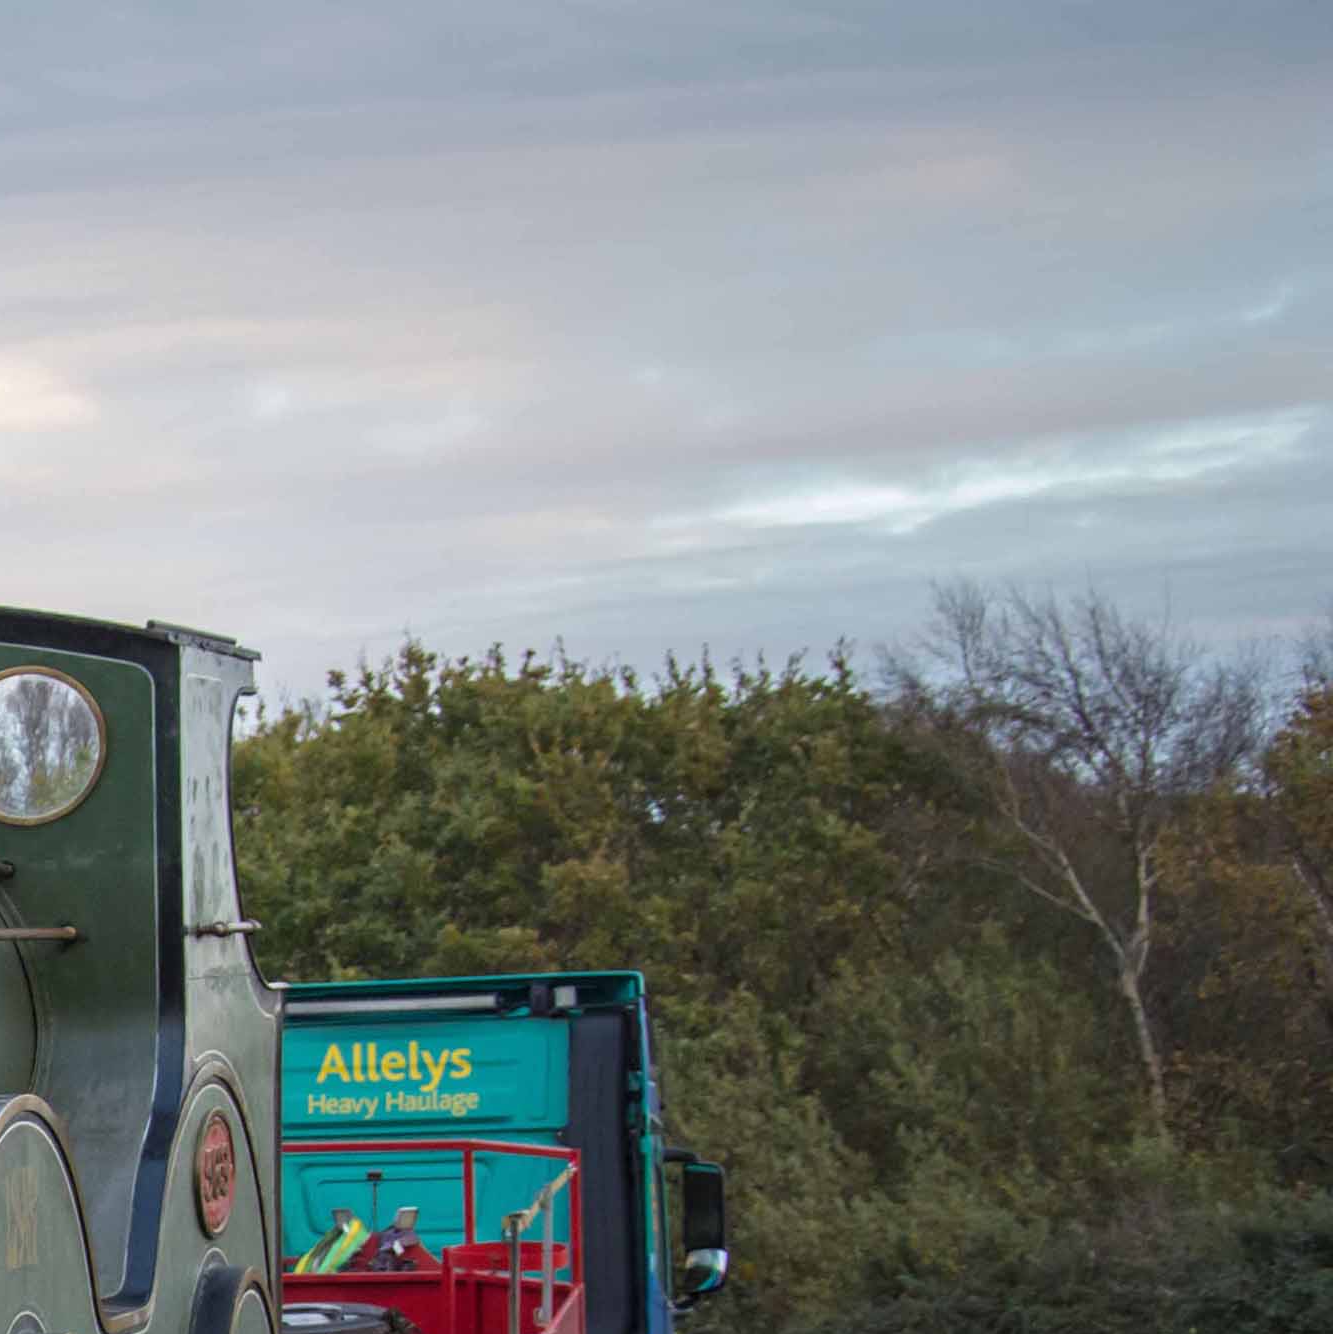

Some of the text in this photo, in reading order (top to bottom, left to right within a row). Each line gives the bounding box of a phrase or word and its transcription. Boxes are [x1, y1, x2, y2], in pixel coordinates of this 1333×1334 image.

[316, 1040, 472, 1092] Allelys
[307, 1089, 480, 1120] Heavy Haulage
